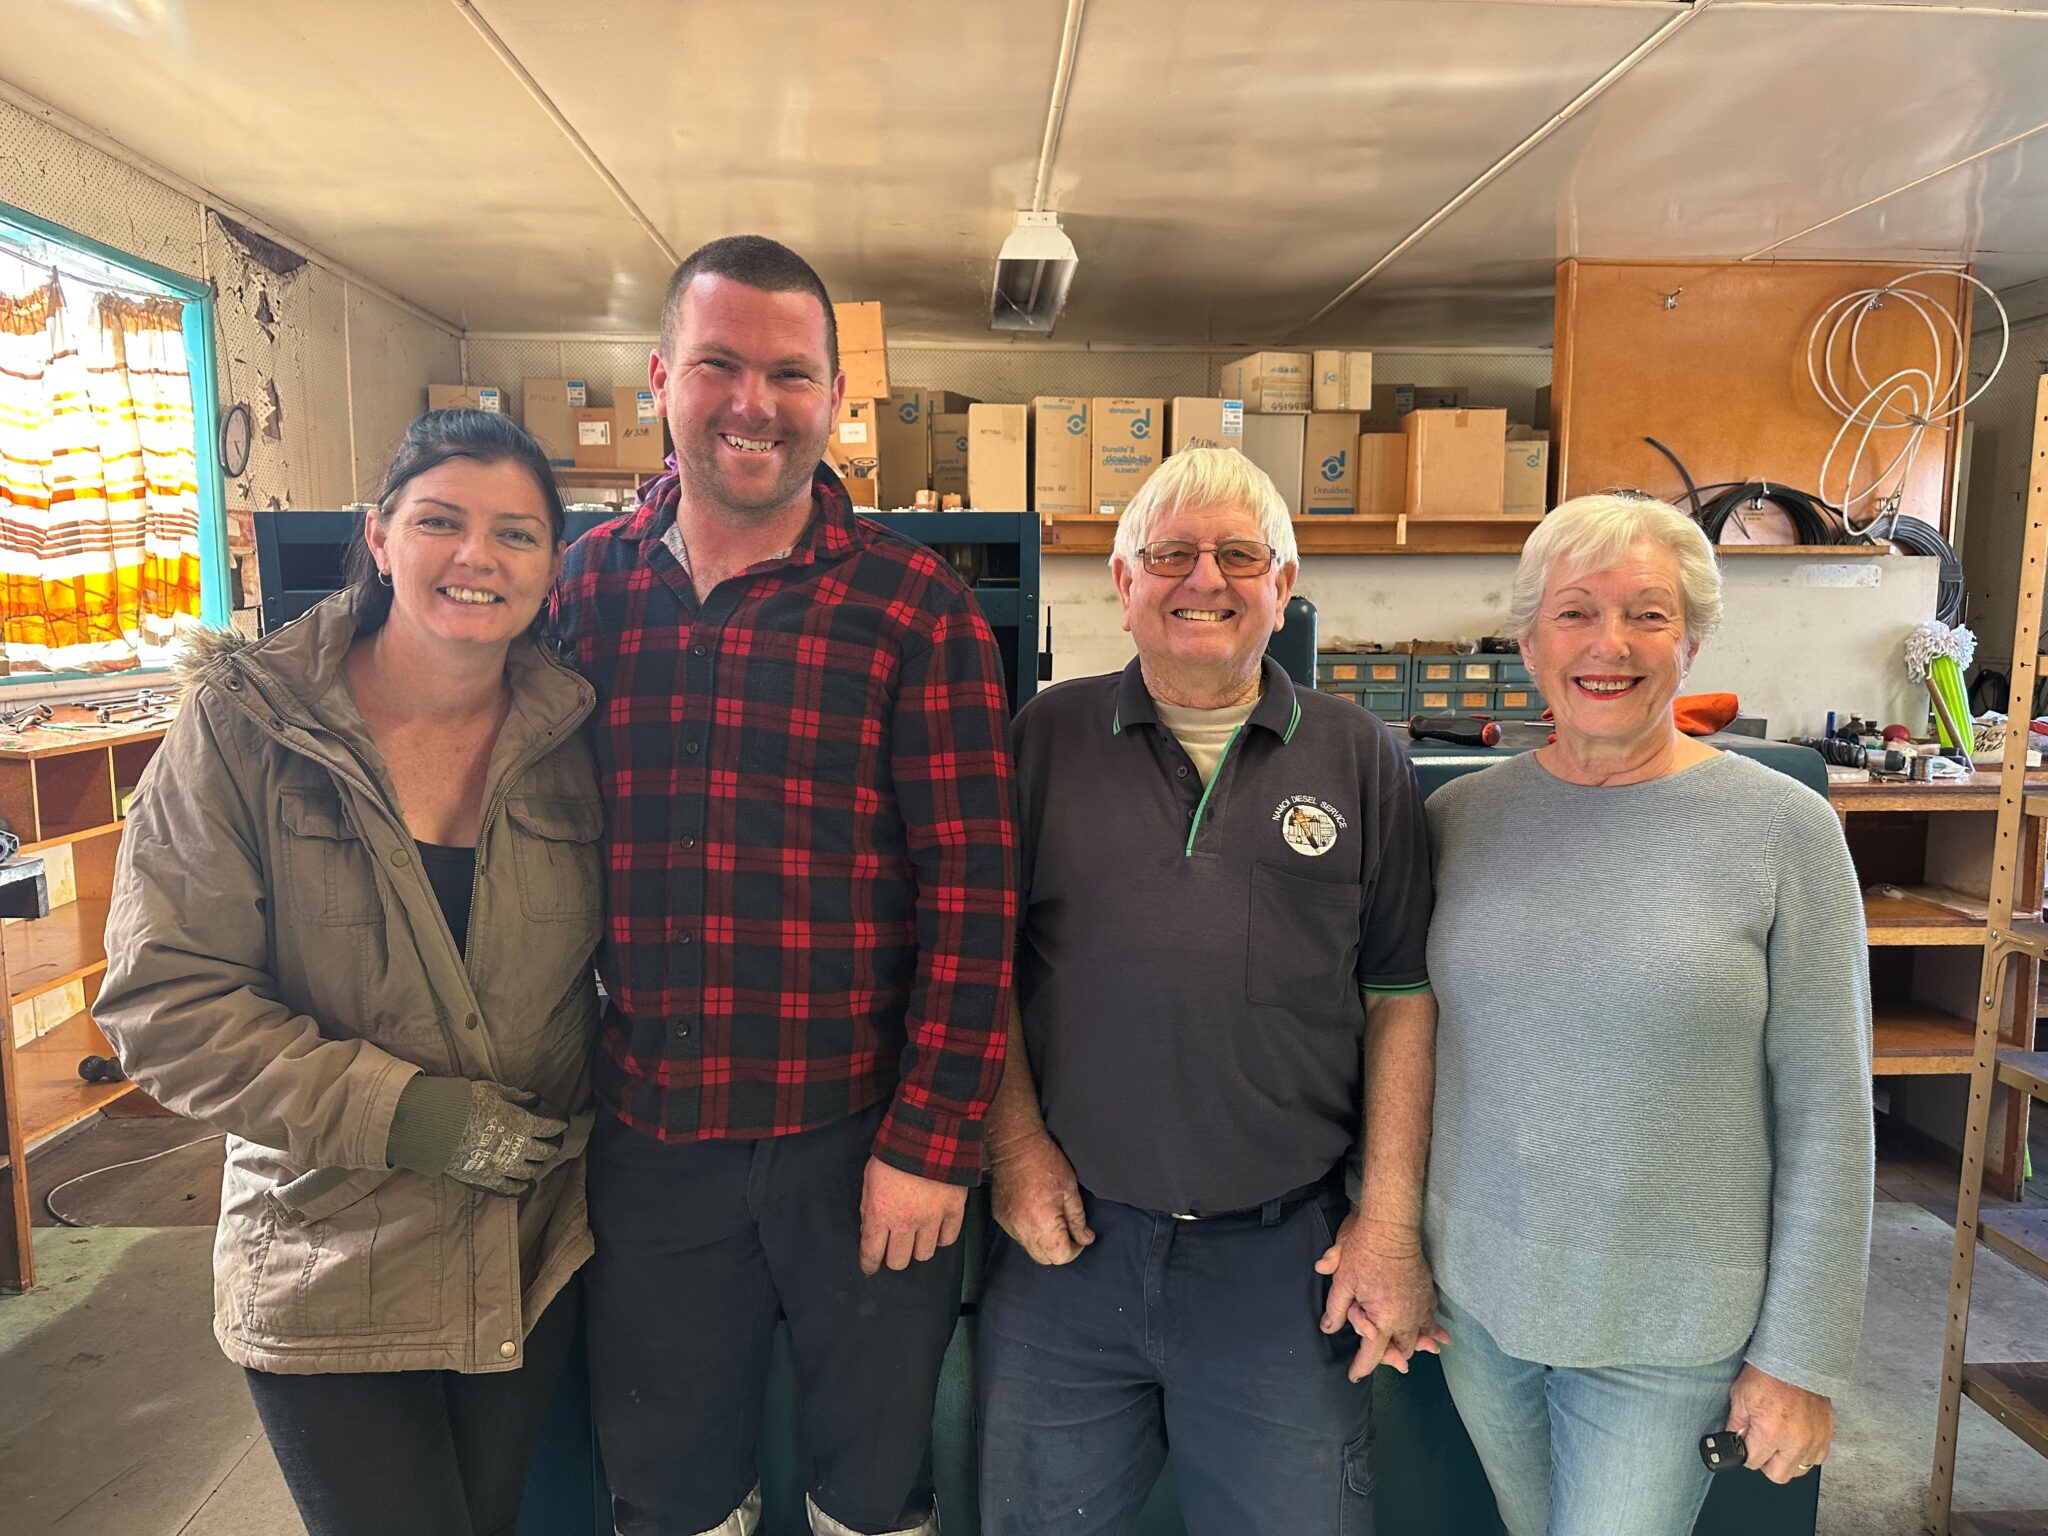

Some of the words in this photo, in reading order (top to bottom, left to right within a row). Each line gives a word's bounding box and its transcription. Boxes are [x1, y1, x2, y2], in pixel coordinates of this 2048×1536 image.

[1108, 406, 1142, 415] donaldson
[1271, 798, 1291, 821] NAMOI
[1291, 795, 1317, 805] DIESEL
[1320, 801, 1347, 829] SERVICE
